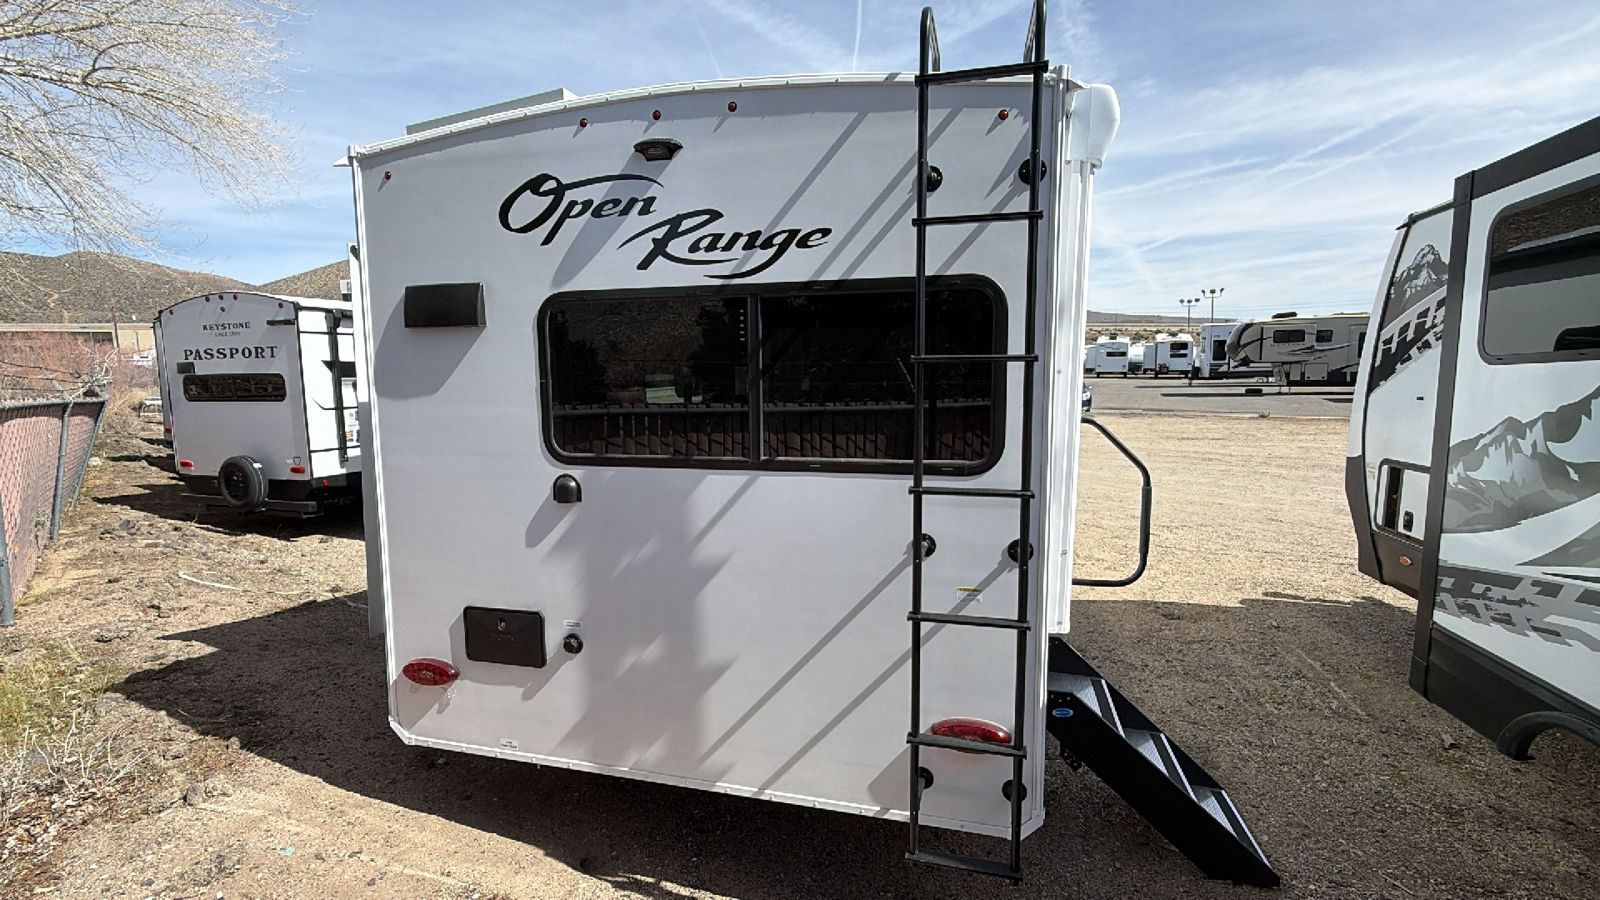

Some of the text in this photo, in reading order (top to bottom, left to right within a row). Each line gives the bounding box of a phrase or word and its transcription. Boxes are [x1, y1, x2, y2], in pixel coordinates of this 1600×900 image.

[498, 173, 664, 247] Open
[616, 208, 833, 280] Range
[202, 322, 251, 330] KEYSTONE
[183, 346, 278, 360] PASSPORT
